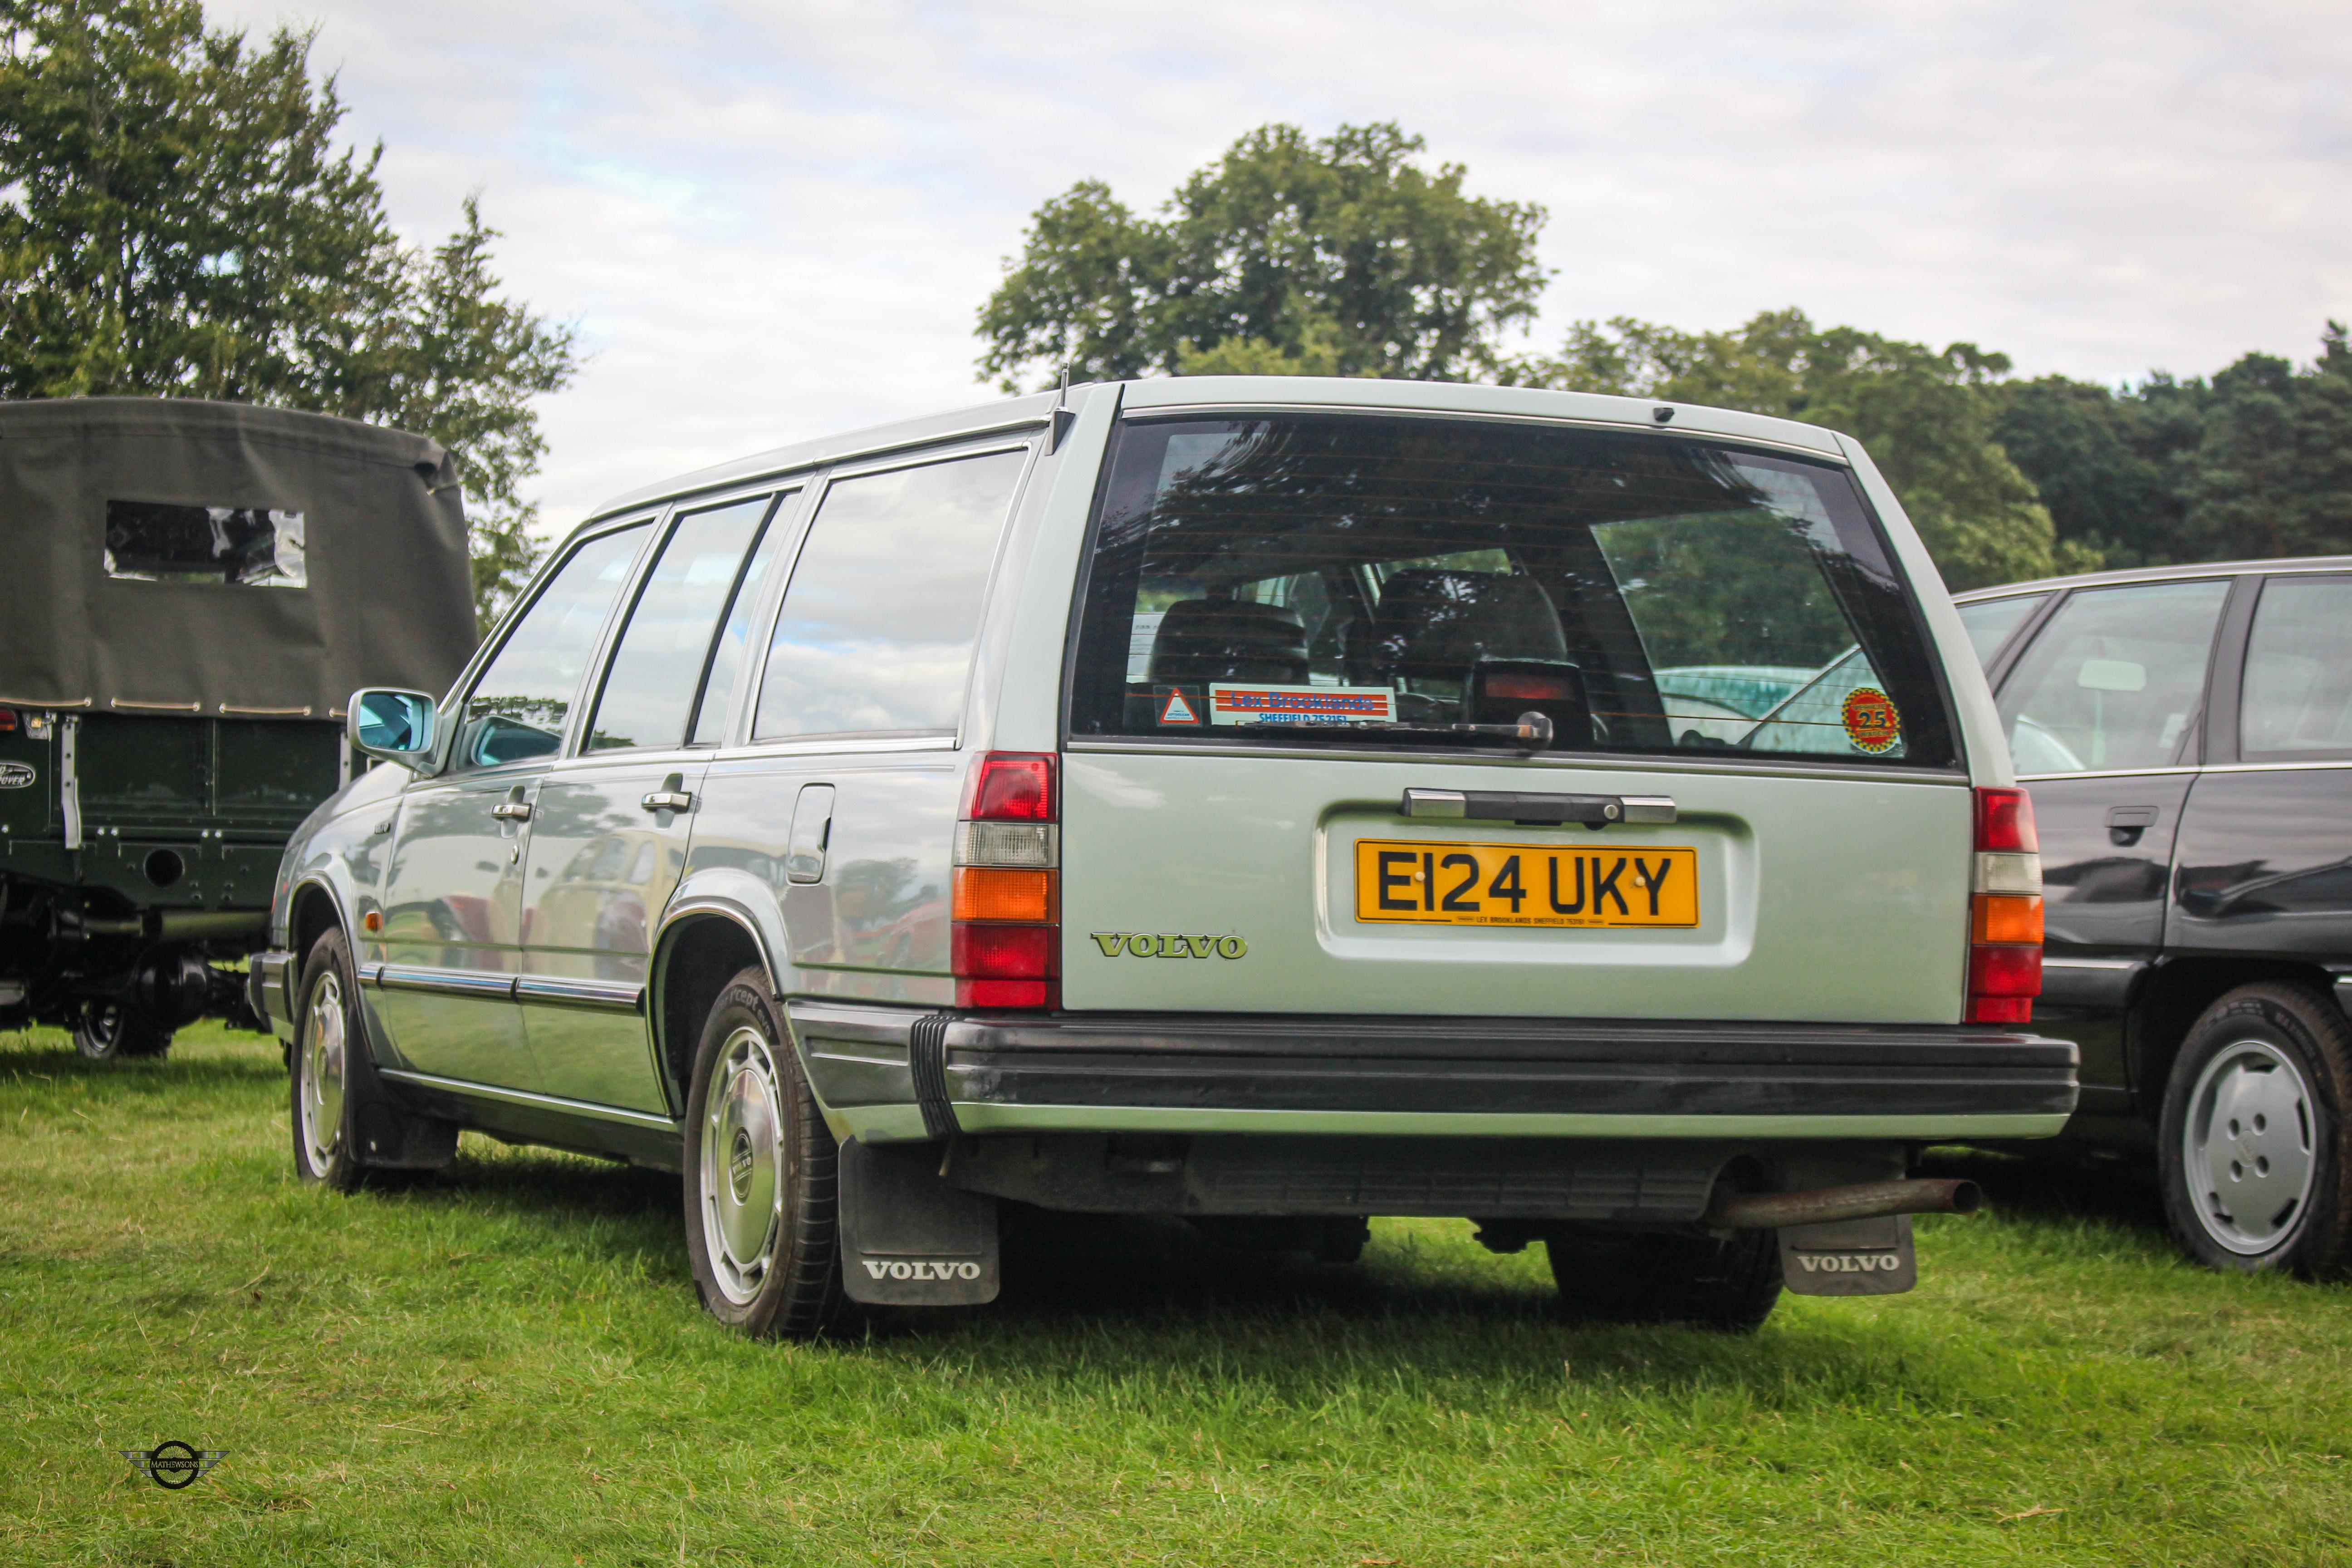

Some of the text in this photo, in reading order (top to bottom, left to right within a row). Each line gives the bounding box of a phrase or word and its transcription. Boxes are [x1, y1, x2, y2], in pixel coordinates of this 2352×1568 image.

[1231, 691, 1374, 710] Lex Brooklands
[1857, 711, 1886, 729] 25
[1378, 851, 1671, 916] E124 UKY
[1091, 932, 1248, 960] VOLVO
[862, 1261, 980, 1280] VOLVO
[1797, 1254, 1900, 1272] VOLVO
